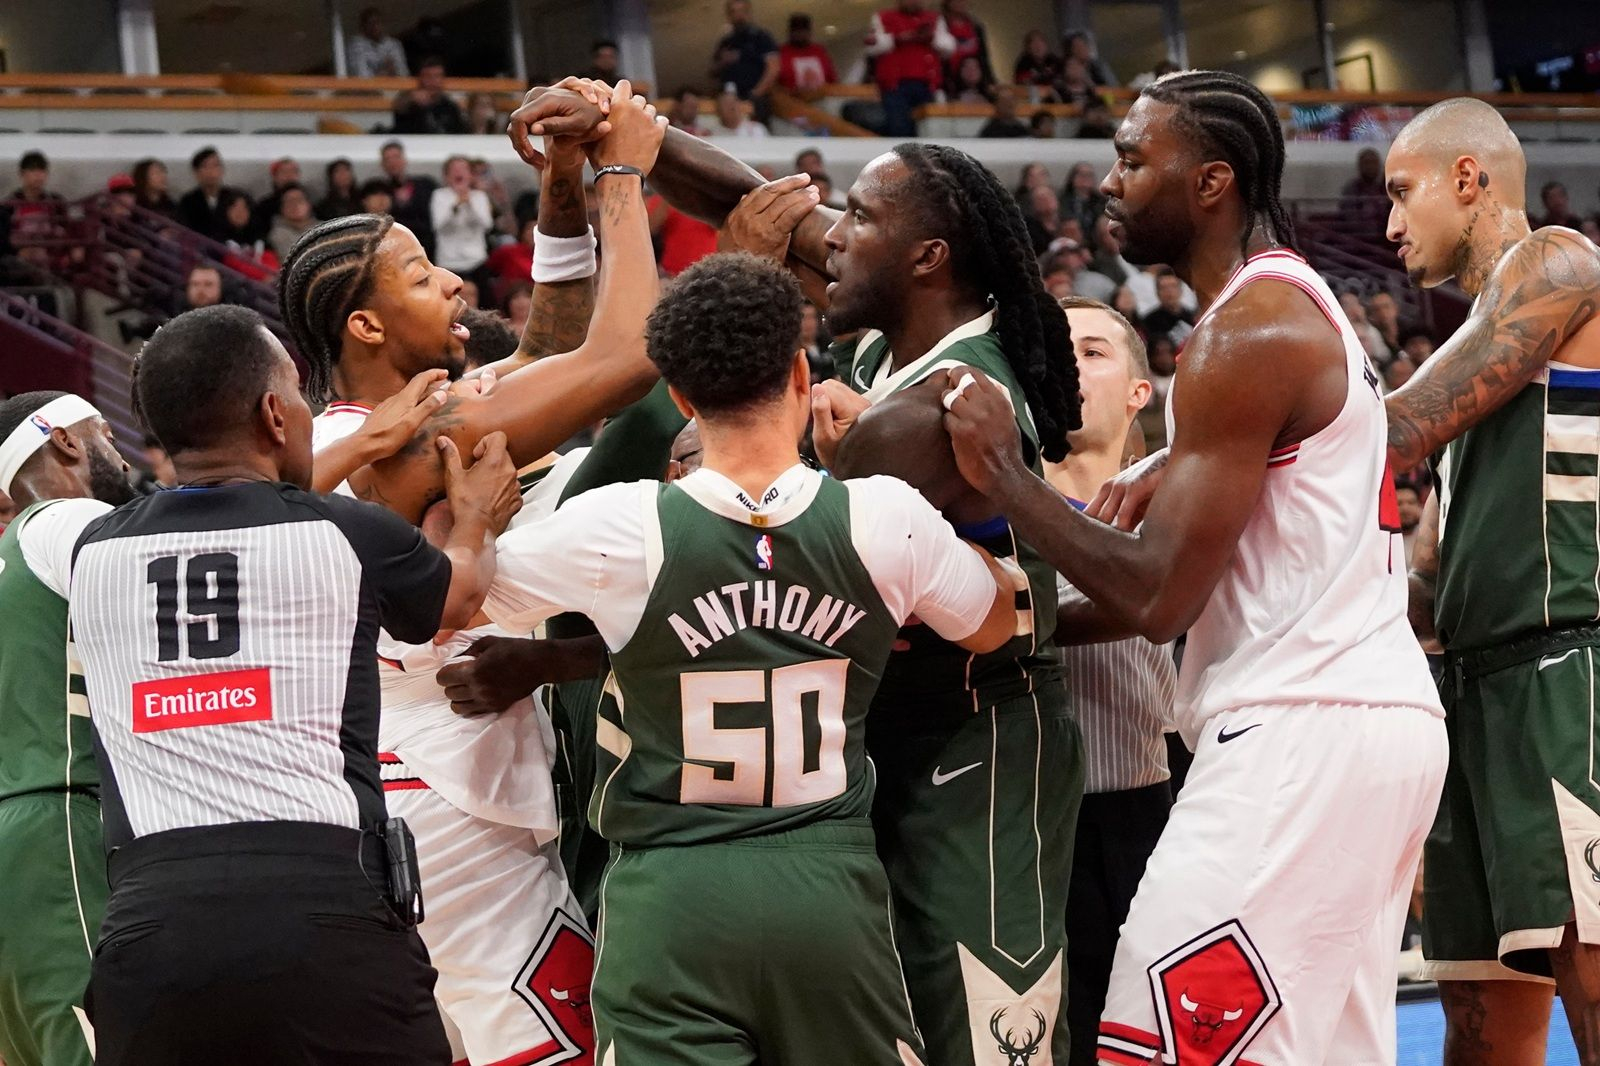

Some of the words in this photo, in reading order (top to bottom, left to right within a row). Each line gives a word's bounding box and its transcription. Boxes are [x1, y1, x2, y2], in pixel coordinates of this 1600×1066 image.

[147, 552, 240, 662] 19
[667, 580, 868, 658] ANTHONY
[144, 686, 257, 718] Emirates
[680, 658, 851, 808] 50
